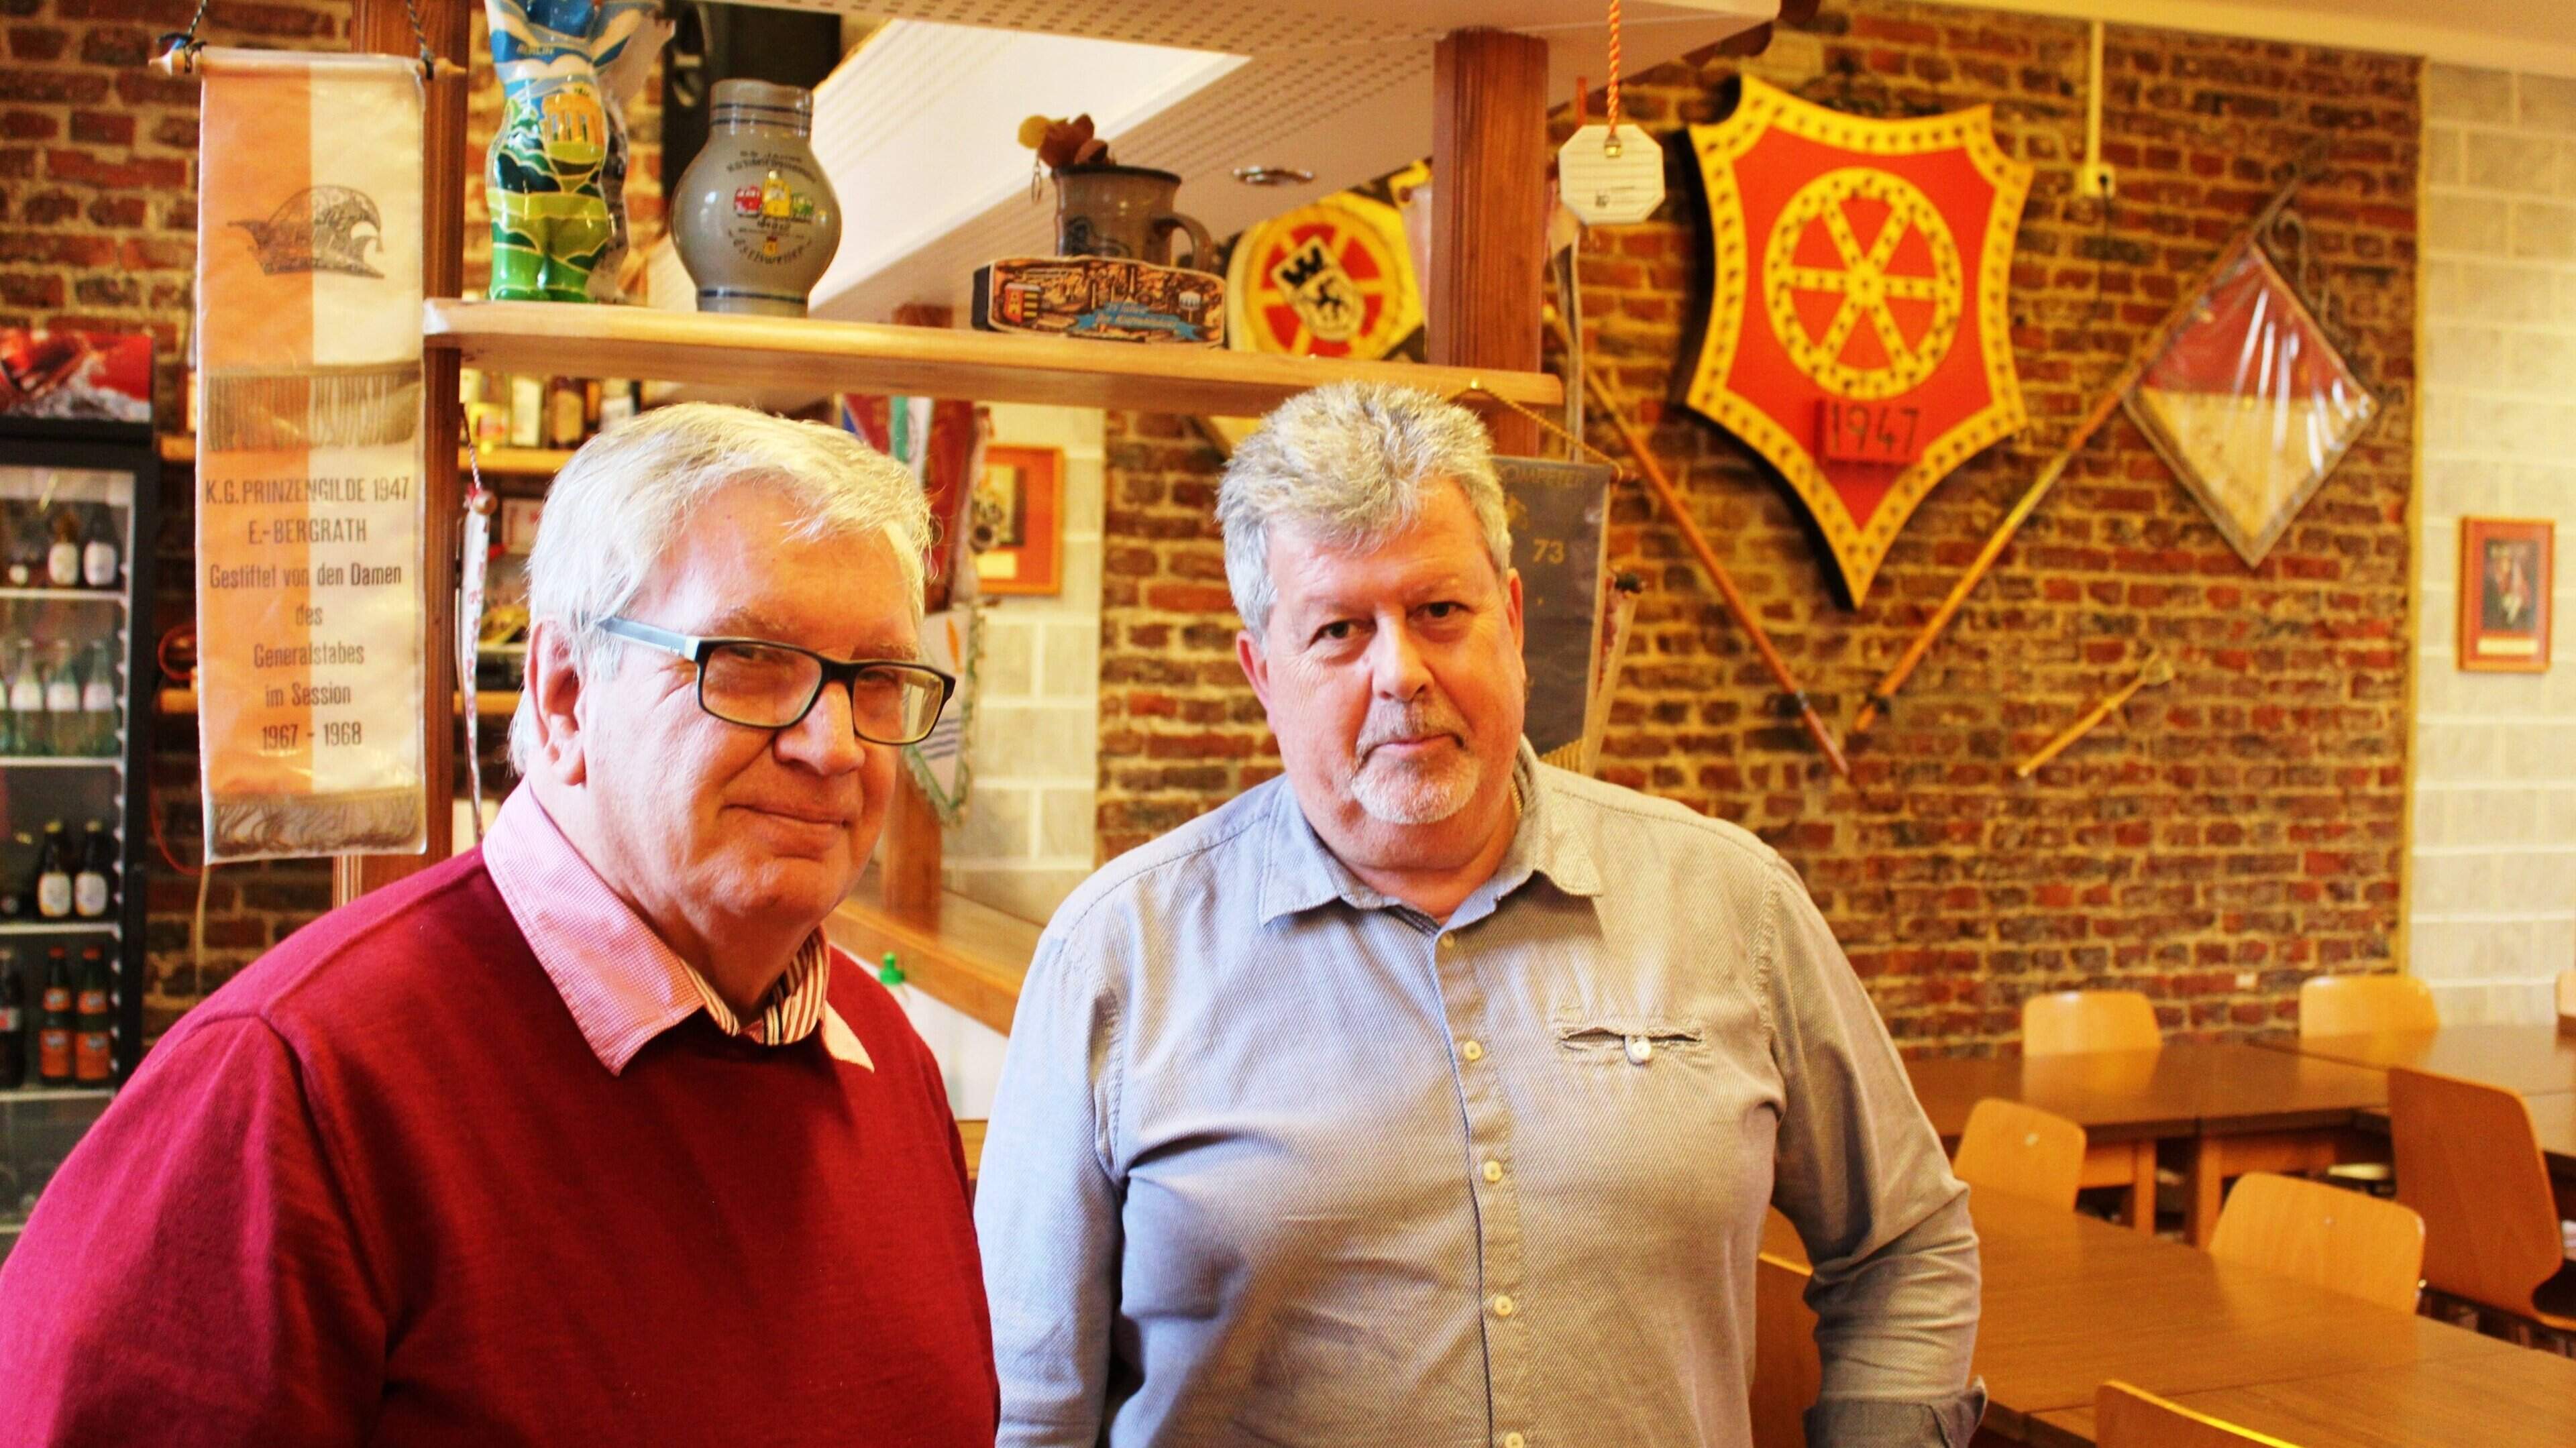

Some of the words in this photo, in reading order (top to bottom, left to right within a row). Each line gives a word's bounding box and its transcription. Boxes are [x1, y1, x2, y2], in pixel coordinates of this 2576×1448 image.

[1832, 403, 1919, 455] 1947
[373, 476, 409, 502] 1947
[1534, 538, 1565, 565] 73
[209, 563, 276, 589] Gestiftet
[282, 567, 309, 587] von
[317, 563, 344, 586] den
[350, 562, 402, 586] Damen
[295, 603, 323, 626] des
[254, 641, 364, 669] Generalstabes
[266, 684, 284, 708] im
[291, 681, 352, 706] Session
[262, 723, 299, 750] 1967
[323, 720, 362, 746] 1968
